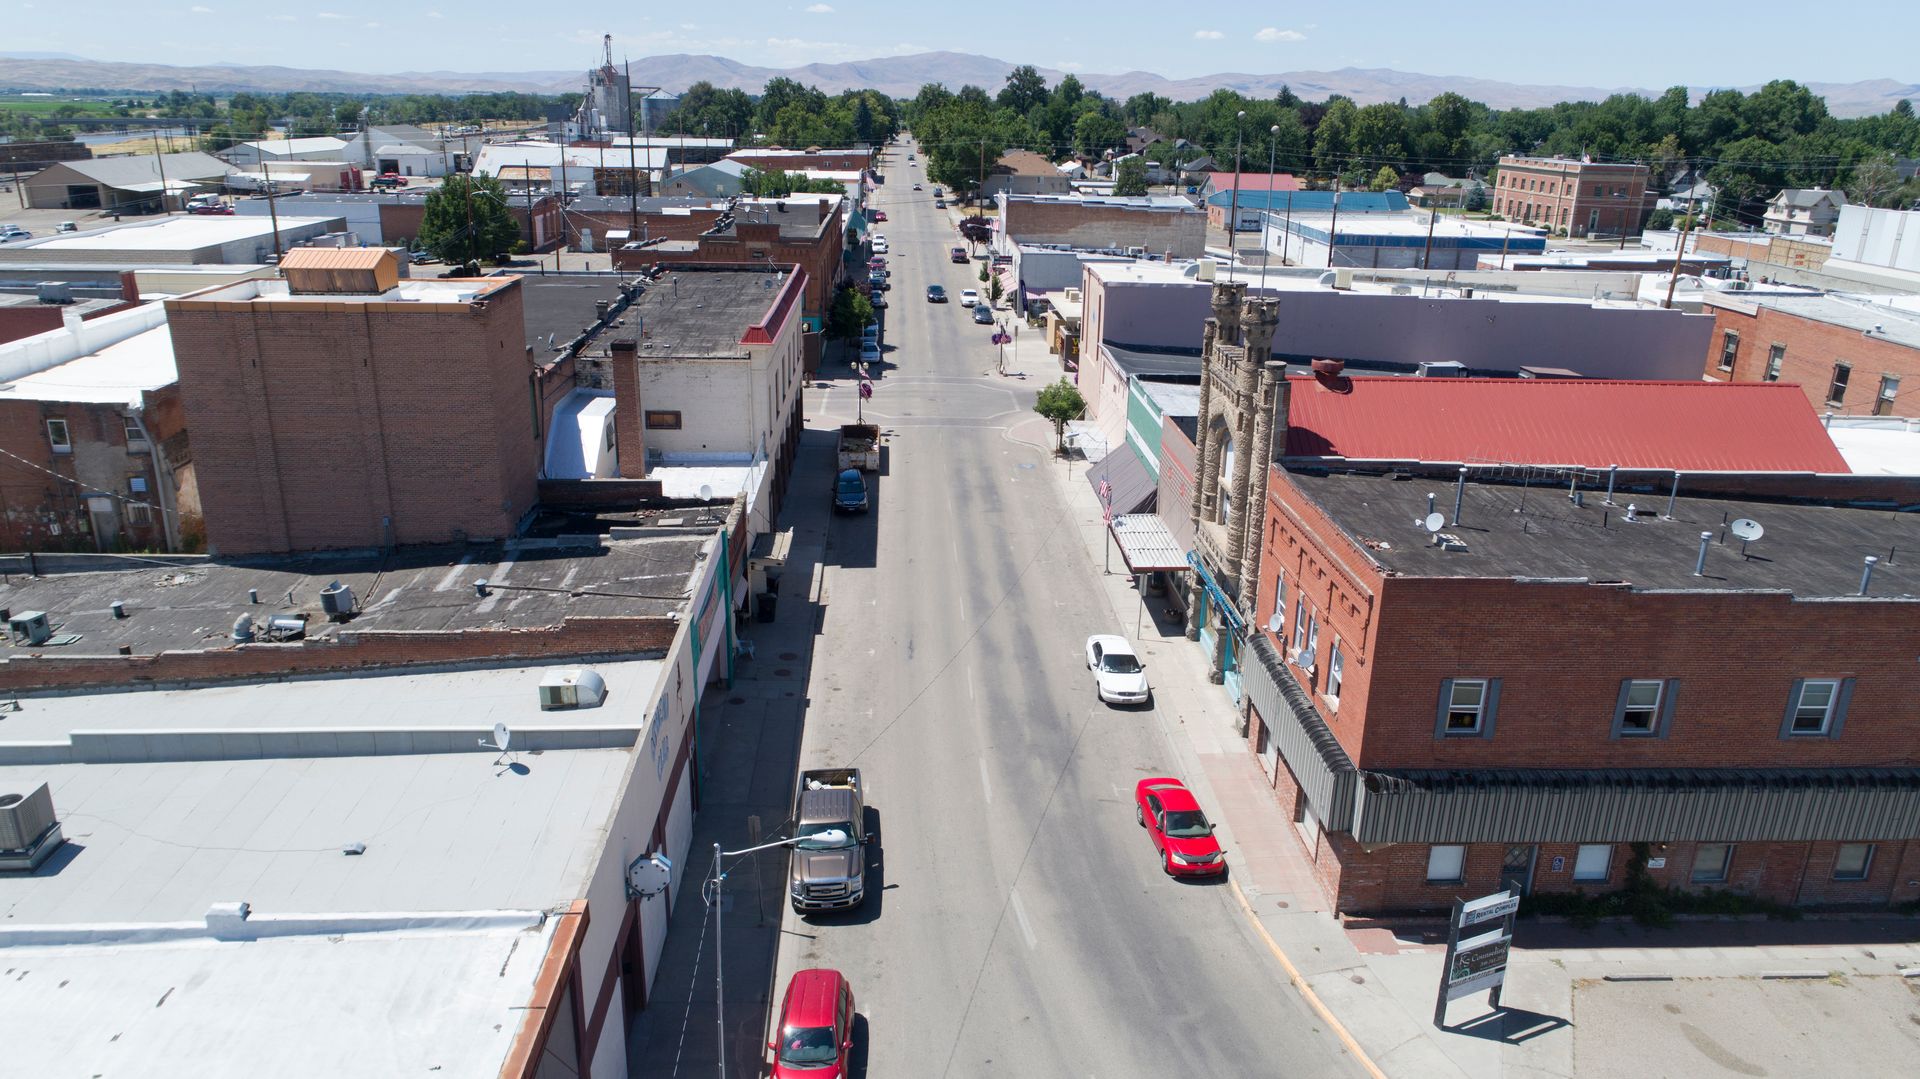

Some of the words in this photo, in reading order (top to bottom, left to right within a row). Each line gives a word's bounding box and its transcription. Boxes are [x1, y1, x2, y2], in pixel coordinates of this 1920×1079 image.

[1476, 909, 1494, 919] RENTAL
[1495, 902, 1517, 914] COMPLEX
[1472, 946, 1507, 962] Counseling
